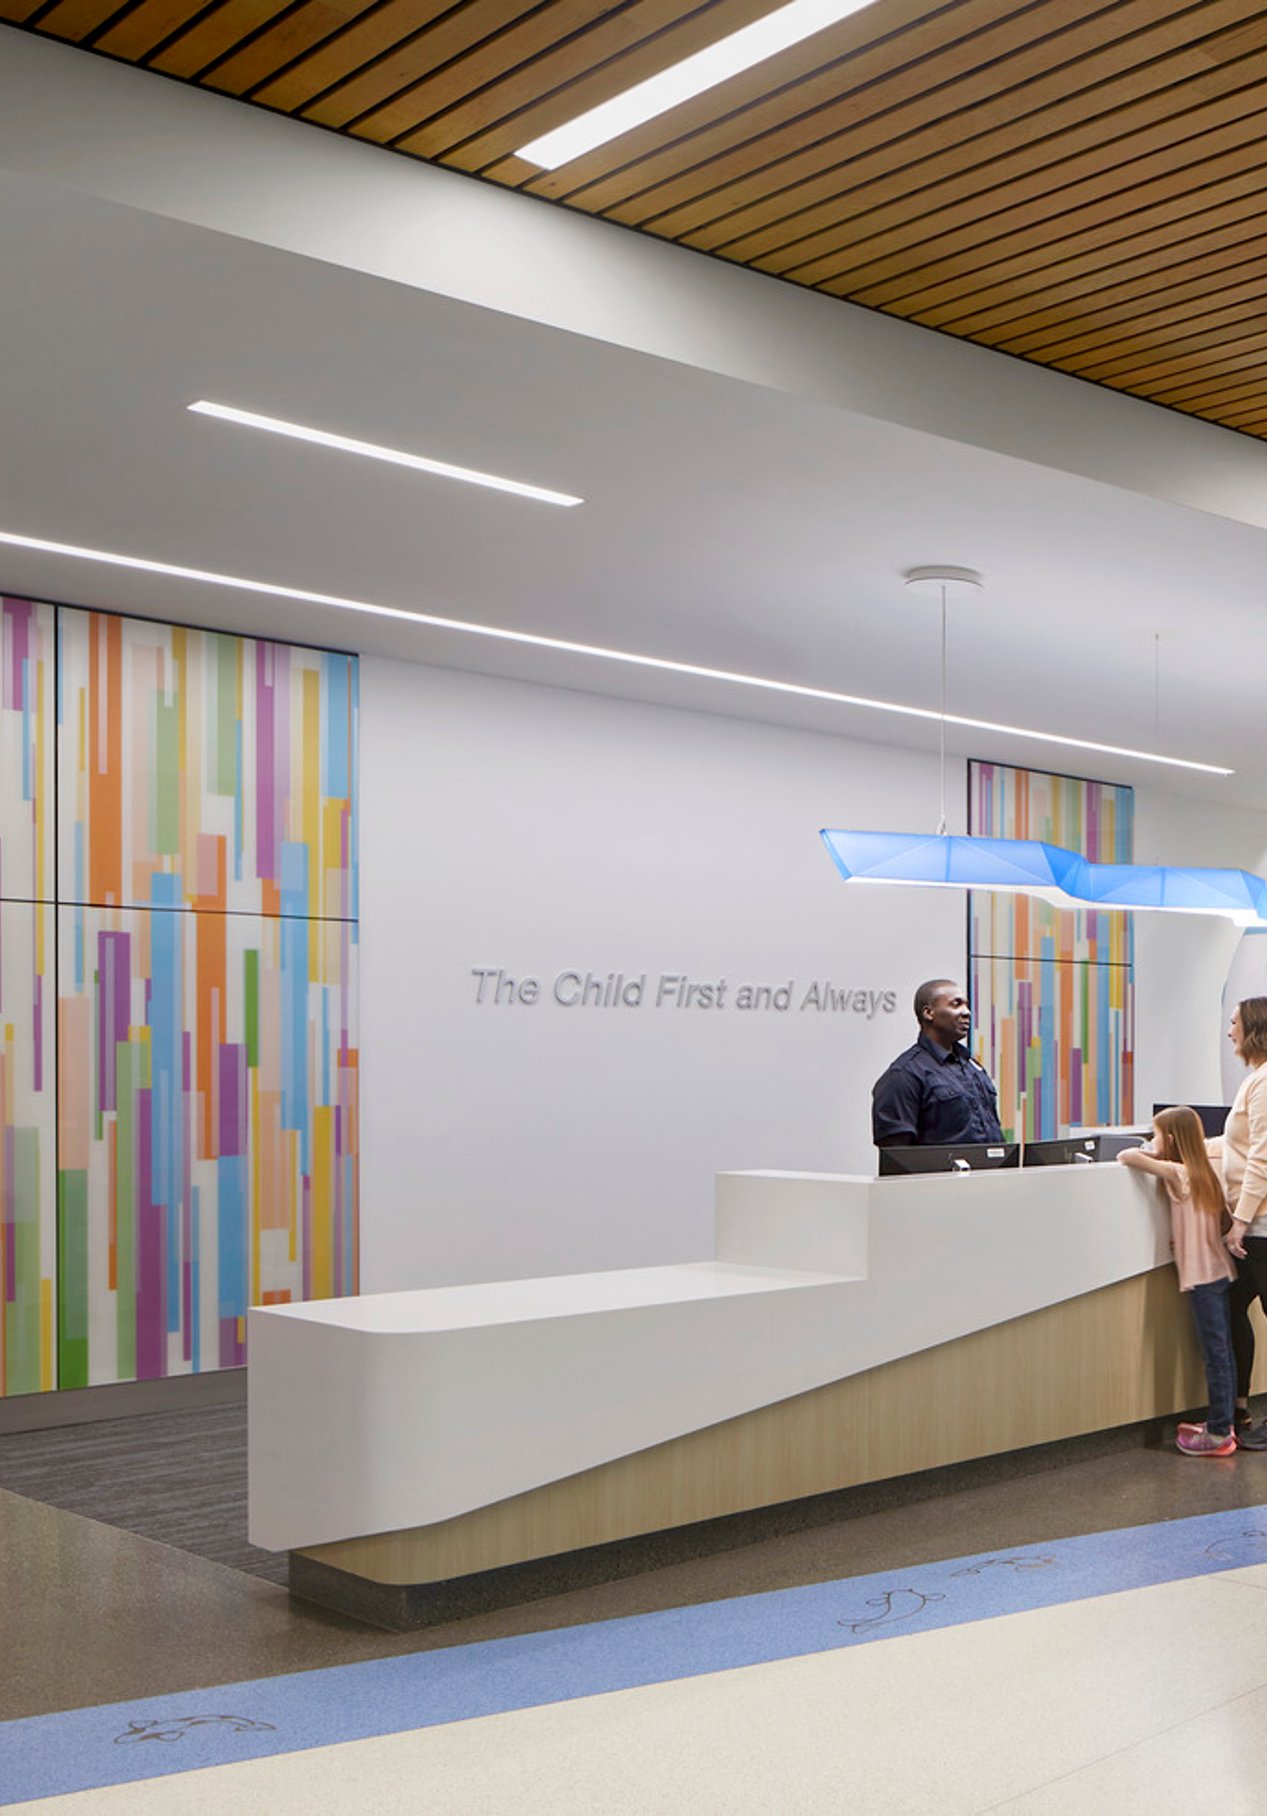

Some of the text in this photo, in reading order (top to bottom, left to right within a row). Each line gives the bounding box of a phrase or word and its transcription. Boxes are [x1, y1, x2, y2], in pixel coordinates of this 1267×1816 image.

[471, 967, 897, 1020] The Child First and Always
